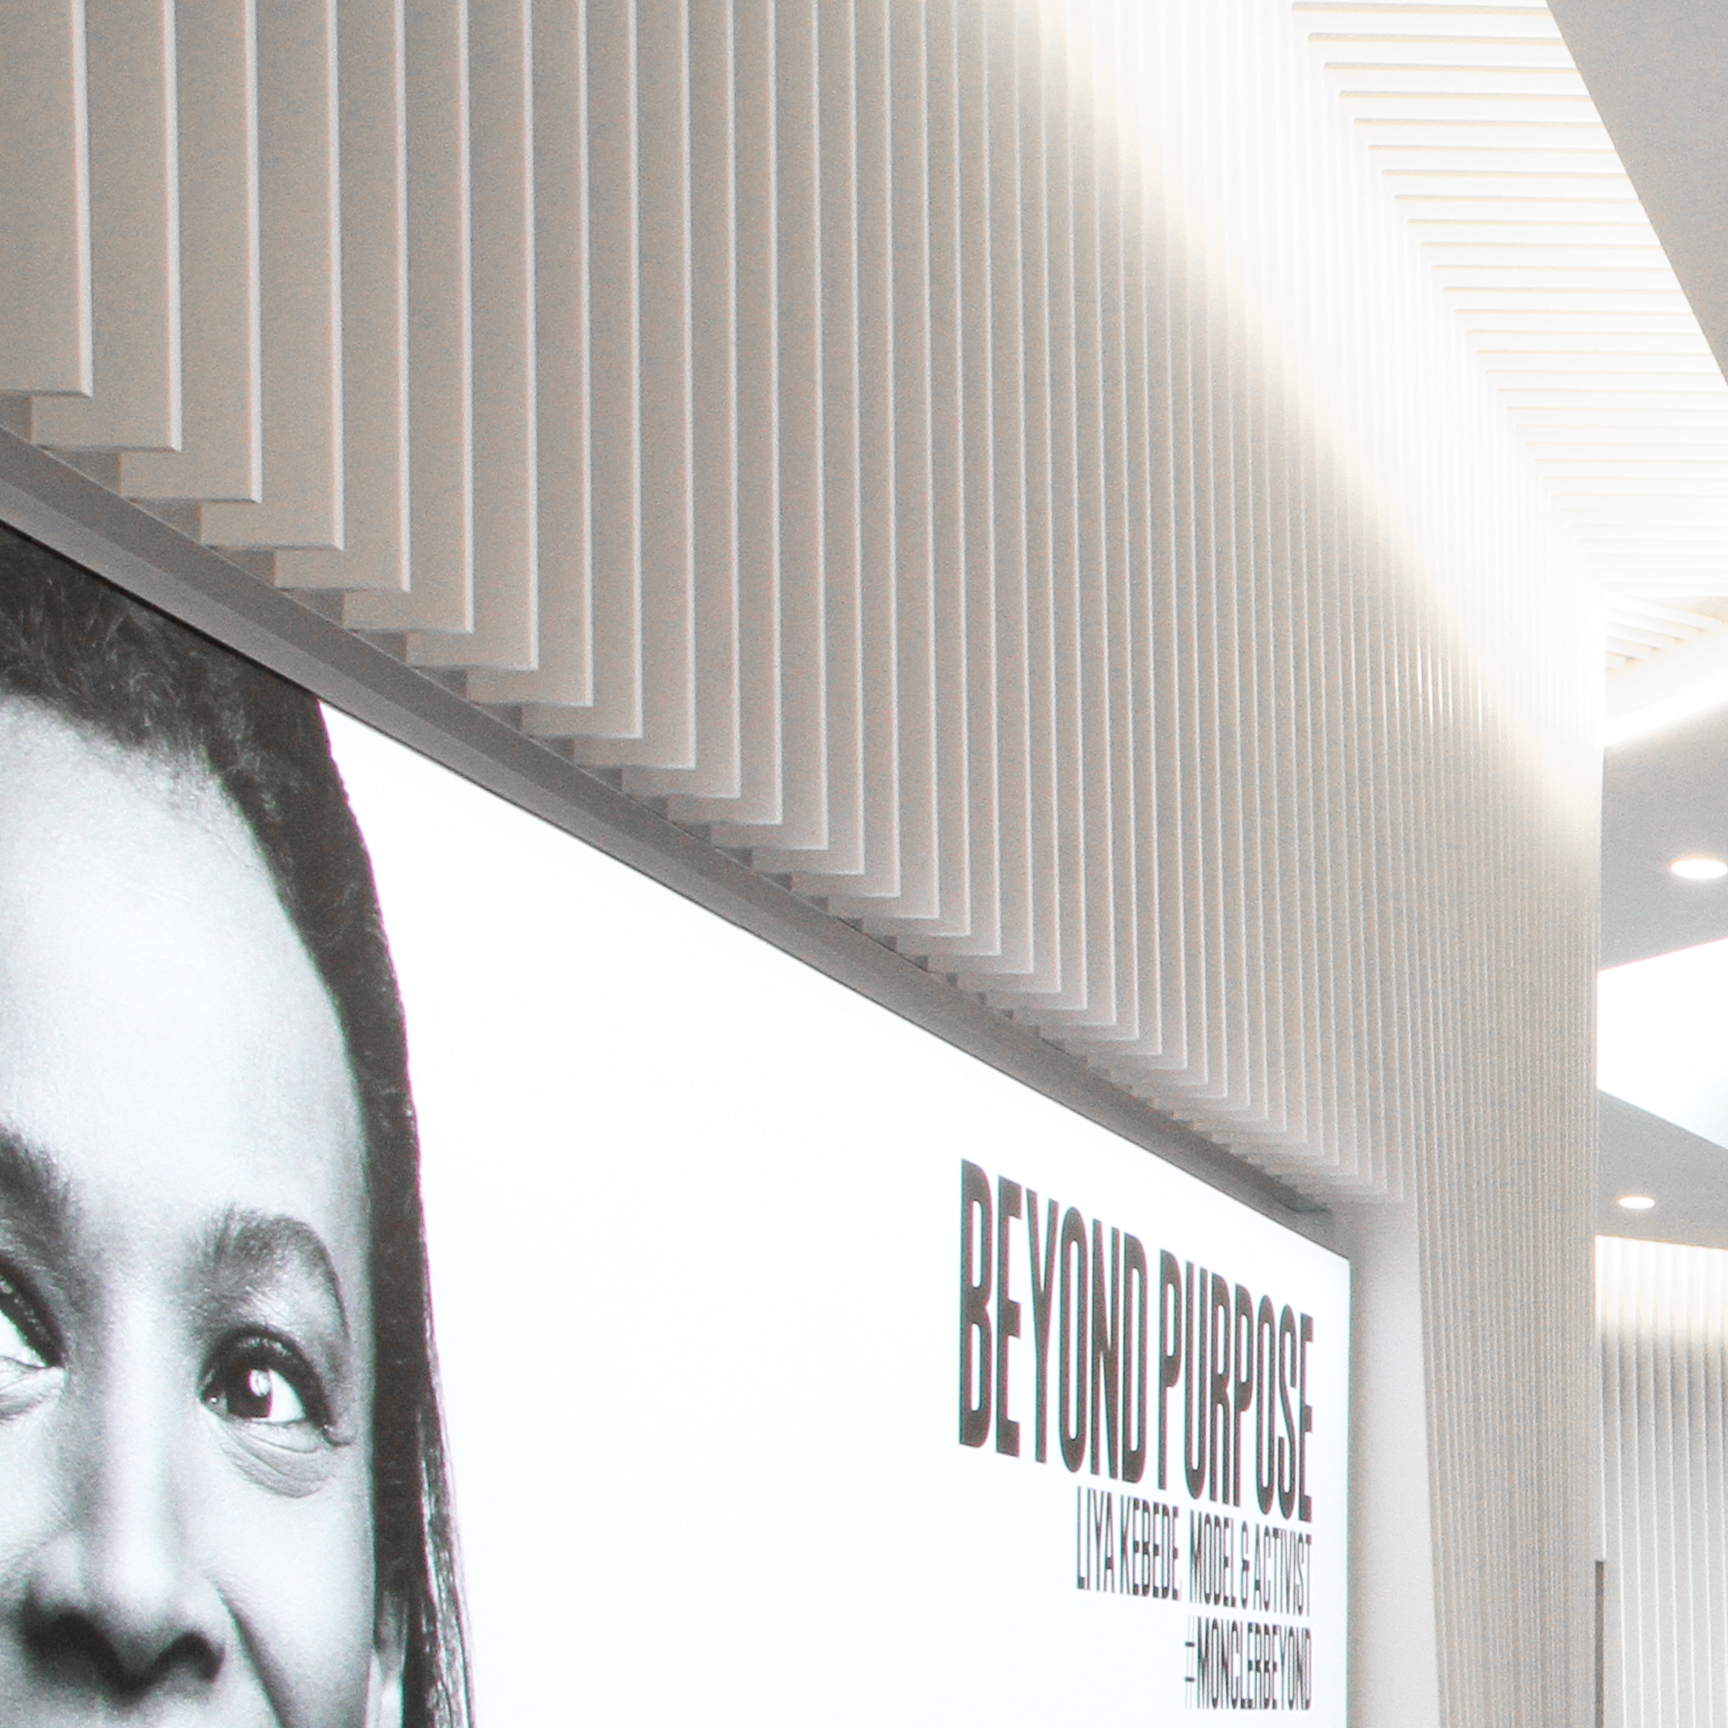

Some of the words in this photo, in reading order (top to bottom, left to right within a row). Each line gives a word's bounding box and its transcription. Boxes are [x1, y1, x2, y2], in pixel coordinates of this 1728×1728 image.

[958, 1156, 1148, 1484] BEYOND
[1157, 1247, 1314, 1523] PURPOSE
[1077, 1485, 1115, 1594] LIYA
[1189, 1509, 1236, 1608] MODEL
[1241, 1520, 1249, 1610] &
[1253, 1522, 1311, 1617] ACTIVIST
[1184, 1614, 1311, 1711] #MONCLERBEYOND
